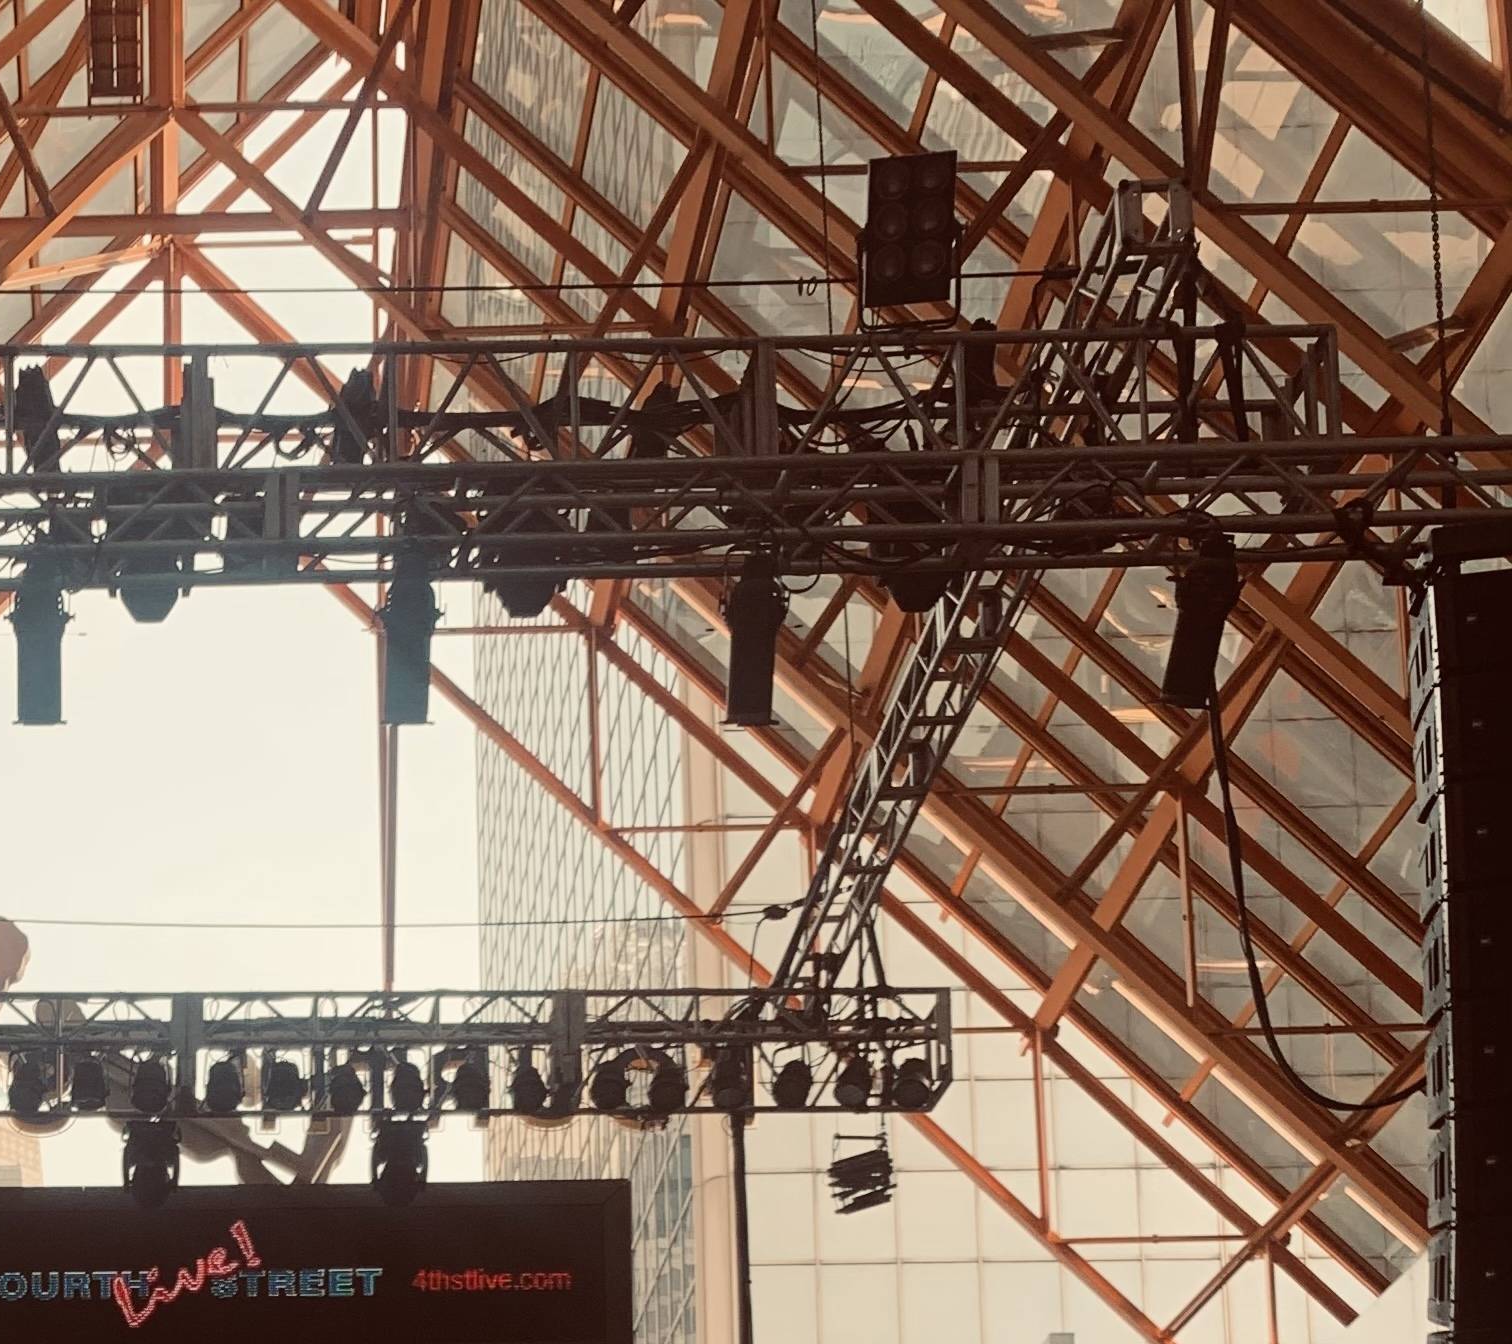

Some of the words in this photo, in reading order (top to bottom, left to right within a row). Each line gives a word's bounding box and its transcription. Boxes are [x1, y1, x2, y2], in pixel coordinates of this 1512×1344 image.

[114, 1219, 262, 1328] Live!
[210, 1267, 384, 1299] STREET
[411, 1267, 572, 1291] 4thstlive.com
